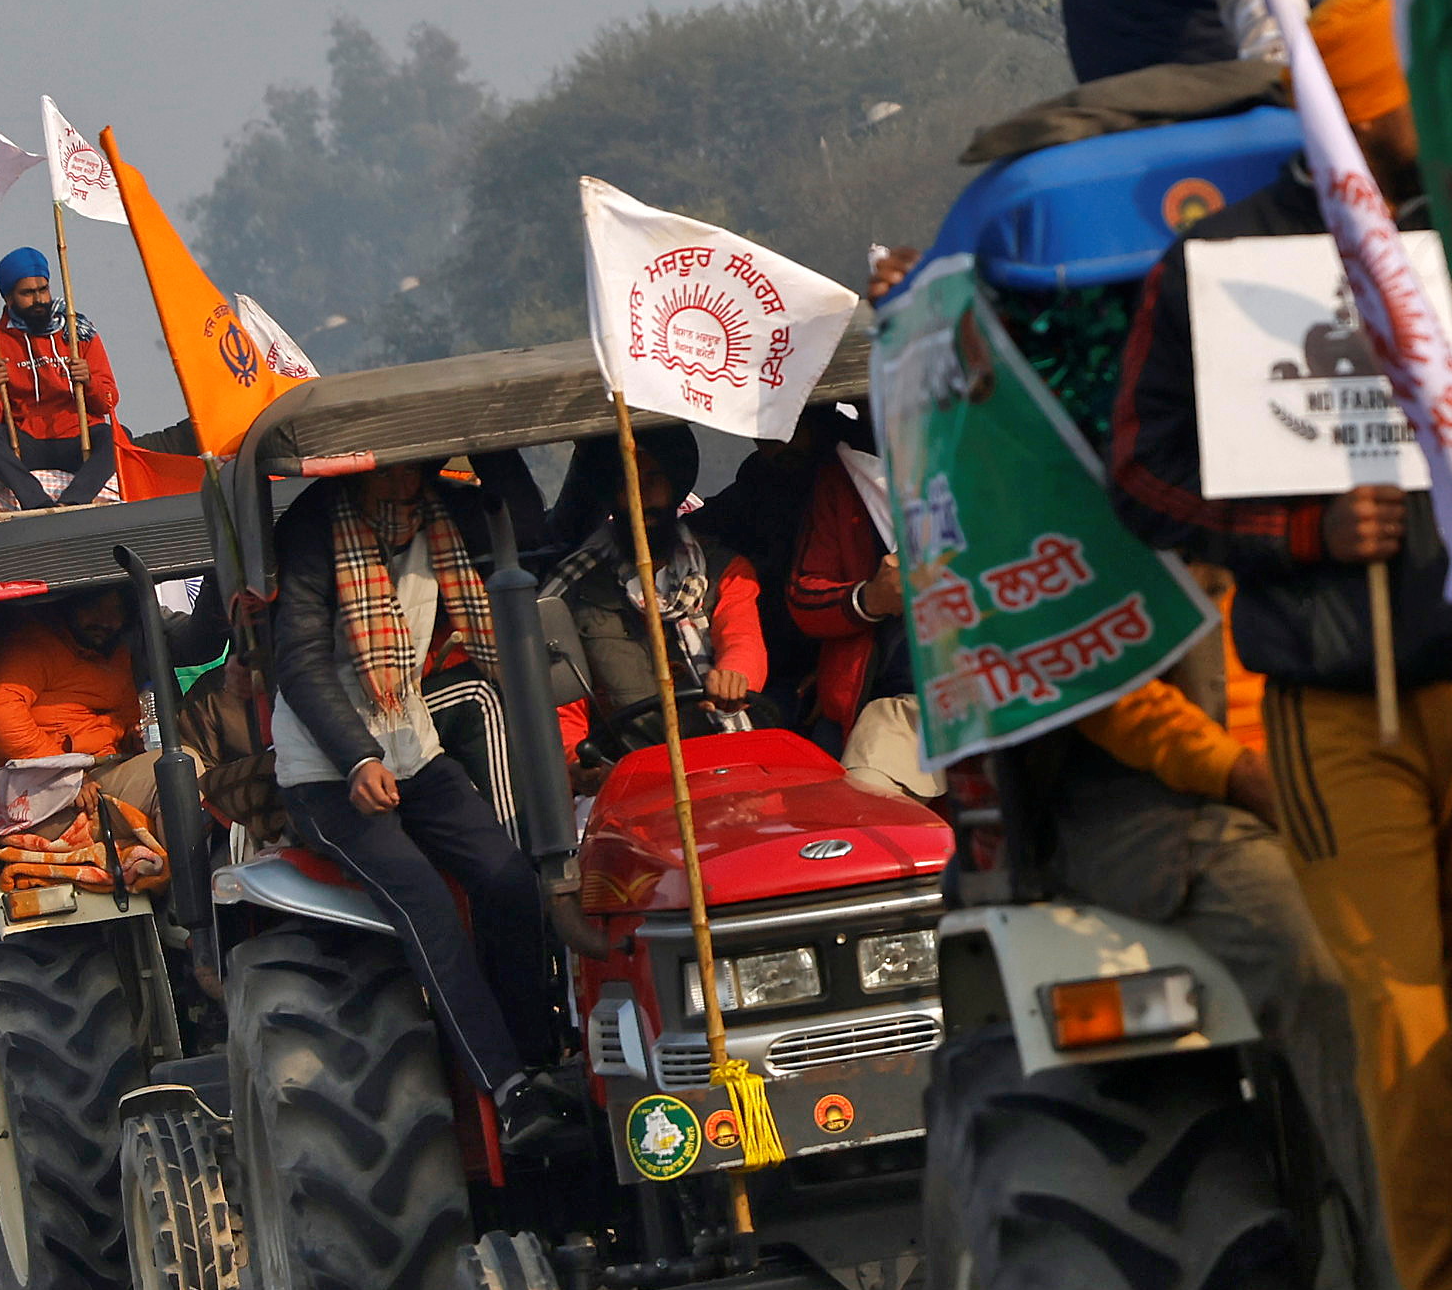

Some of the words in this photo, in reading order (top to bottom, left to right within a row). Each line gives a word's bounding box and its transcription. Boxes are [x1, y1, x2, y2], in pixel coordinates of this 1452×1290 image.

[629, 282, 647, 361] ਕਿਸਾਨ
[644, 247, 716, 283] ਮਜ਼ਦੂਰ
[724, 253, 786, 315] ਸੰਘਰਸ਼
[759, 326, 795, 389] ਕਮੇਟੀ
[680, 379, 714, 413] ਪੰਜਾਬ
[1309, 391, 1331, 410] NO
[1333, 423, 1356, 445] NO
[984, 536, 1089, 609] ਲਈ
